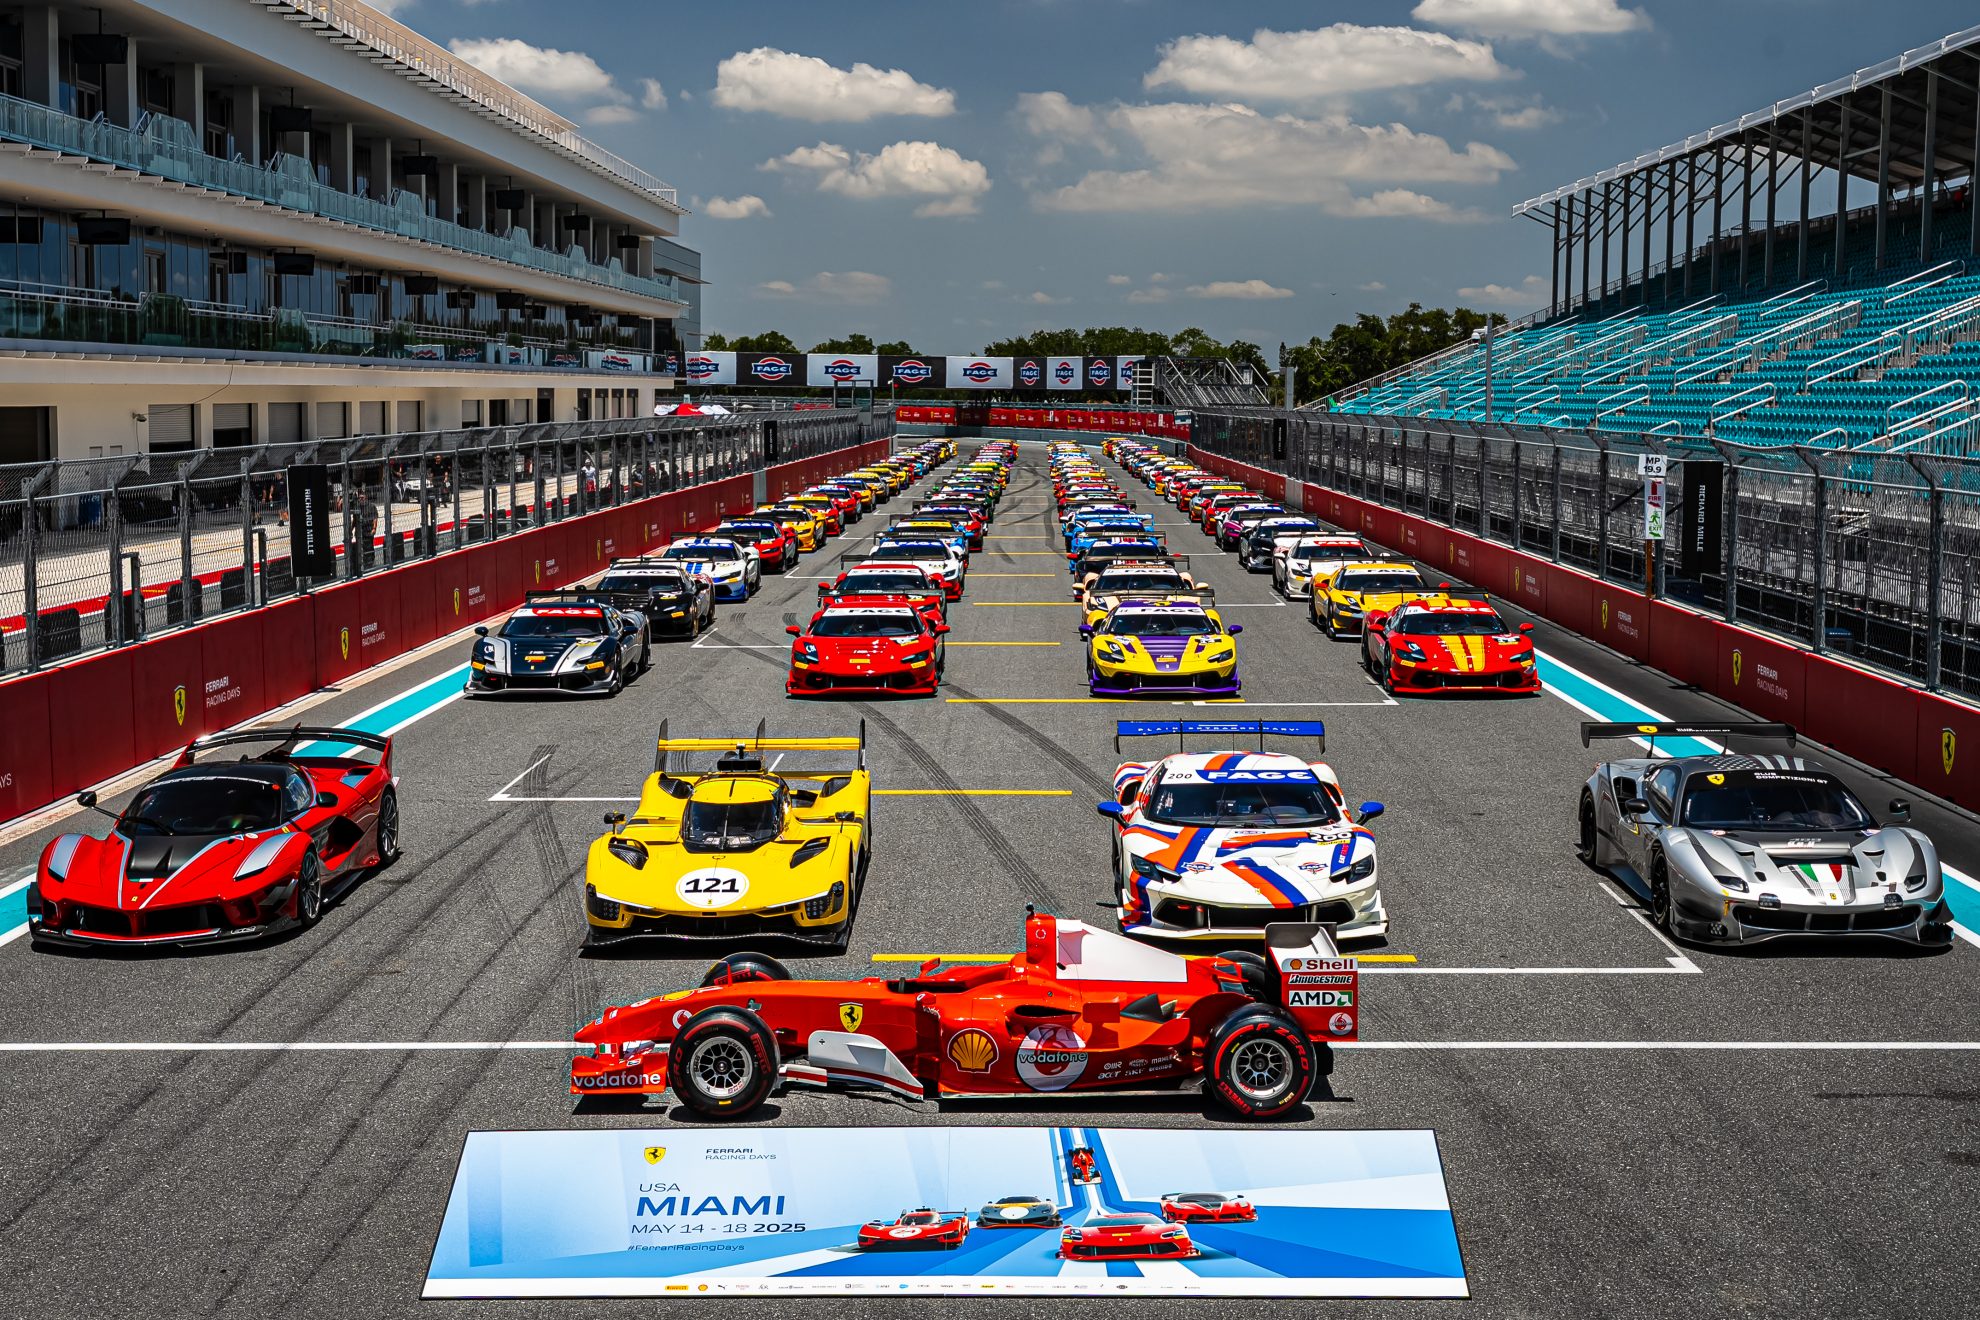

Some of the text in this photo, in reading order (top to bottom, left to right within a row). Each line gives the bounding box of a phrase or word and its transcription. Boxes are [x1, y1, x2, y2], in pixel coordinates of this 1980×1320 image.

[304, 488, 315, 555] RICHARD MILLE
[1696, 484, 1706, 552] RICHARD MILLE
[1617, 610, 1632, 623] FERRARI
[361, 622, 378, 635] FERRARI
[361, 630, 386, 647] RACING DAYS
[1757, 664, 1778, 680] FERRARI
[205, 676, 229, 693] FERRARI
[1757, 678, 1788, 700] RACING DAYS
[206, 687, 241, 708] RACING DAYS
[1208, 771, 1313, 780] FAGE
[1756, 775, 1816, 783] COMPETIZIONI
[1311, 831, 1352, 842] 200
[684, 878, 740, 893] 121
[1306, 959, 1354, 970] Shell
[1288, 974, 1354, 984] BRIDGESTONE
[1289, 991, 1336, 1005] AMD
[1274, 1026, 1309, 1071] ZERO
[1019, 1050, 1088, 1064] vodafone
[573, 1070, 661, 1088] vodafone
[1097, 1070, 1121, 1079] acer
[639, 1182, 681, 1193] USA
[636, 1195, 786, 1217] MIAMI
[631, 1224, 676, 1234] MAY
[680, 1223, 705, 1233] 14
[722, 1223, 748, 1233] 18
[752, 1223, 807, 1233] 2025
[627, 1244, 745, 1252] #FerrariRacingDays
